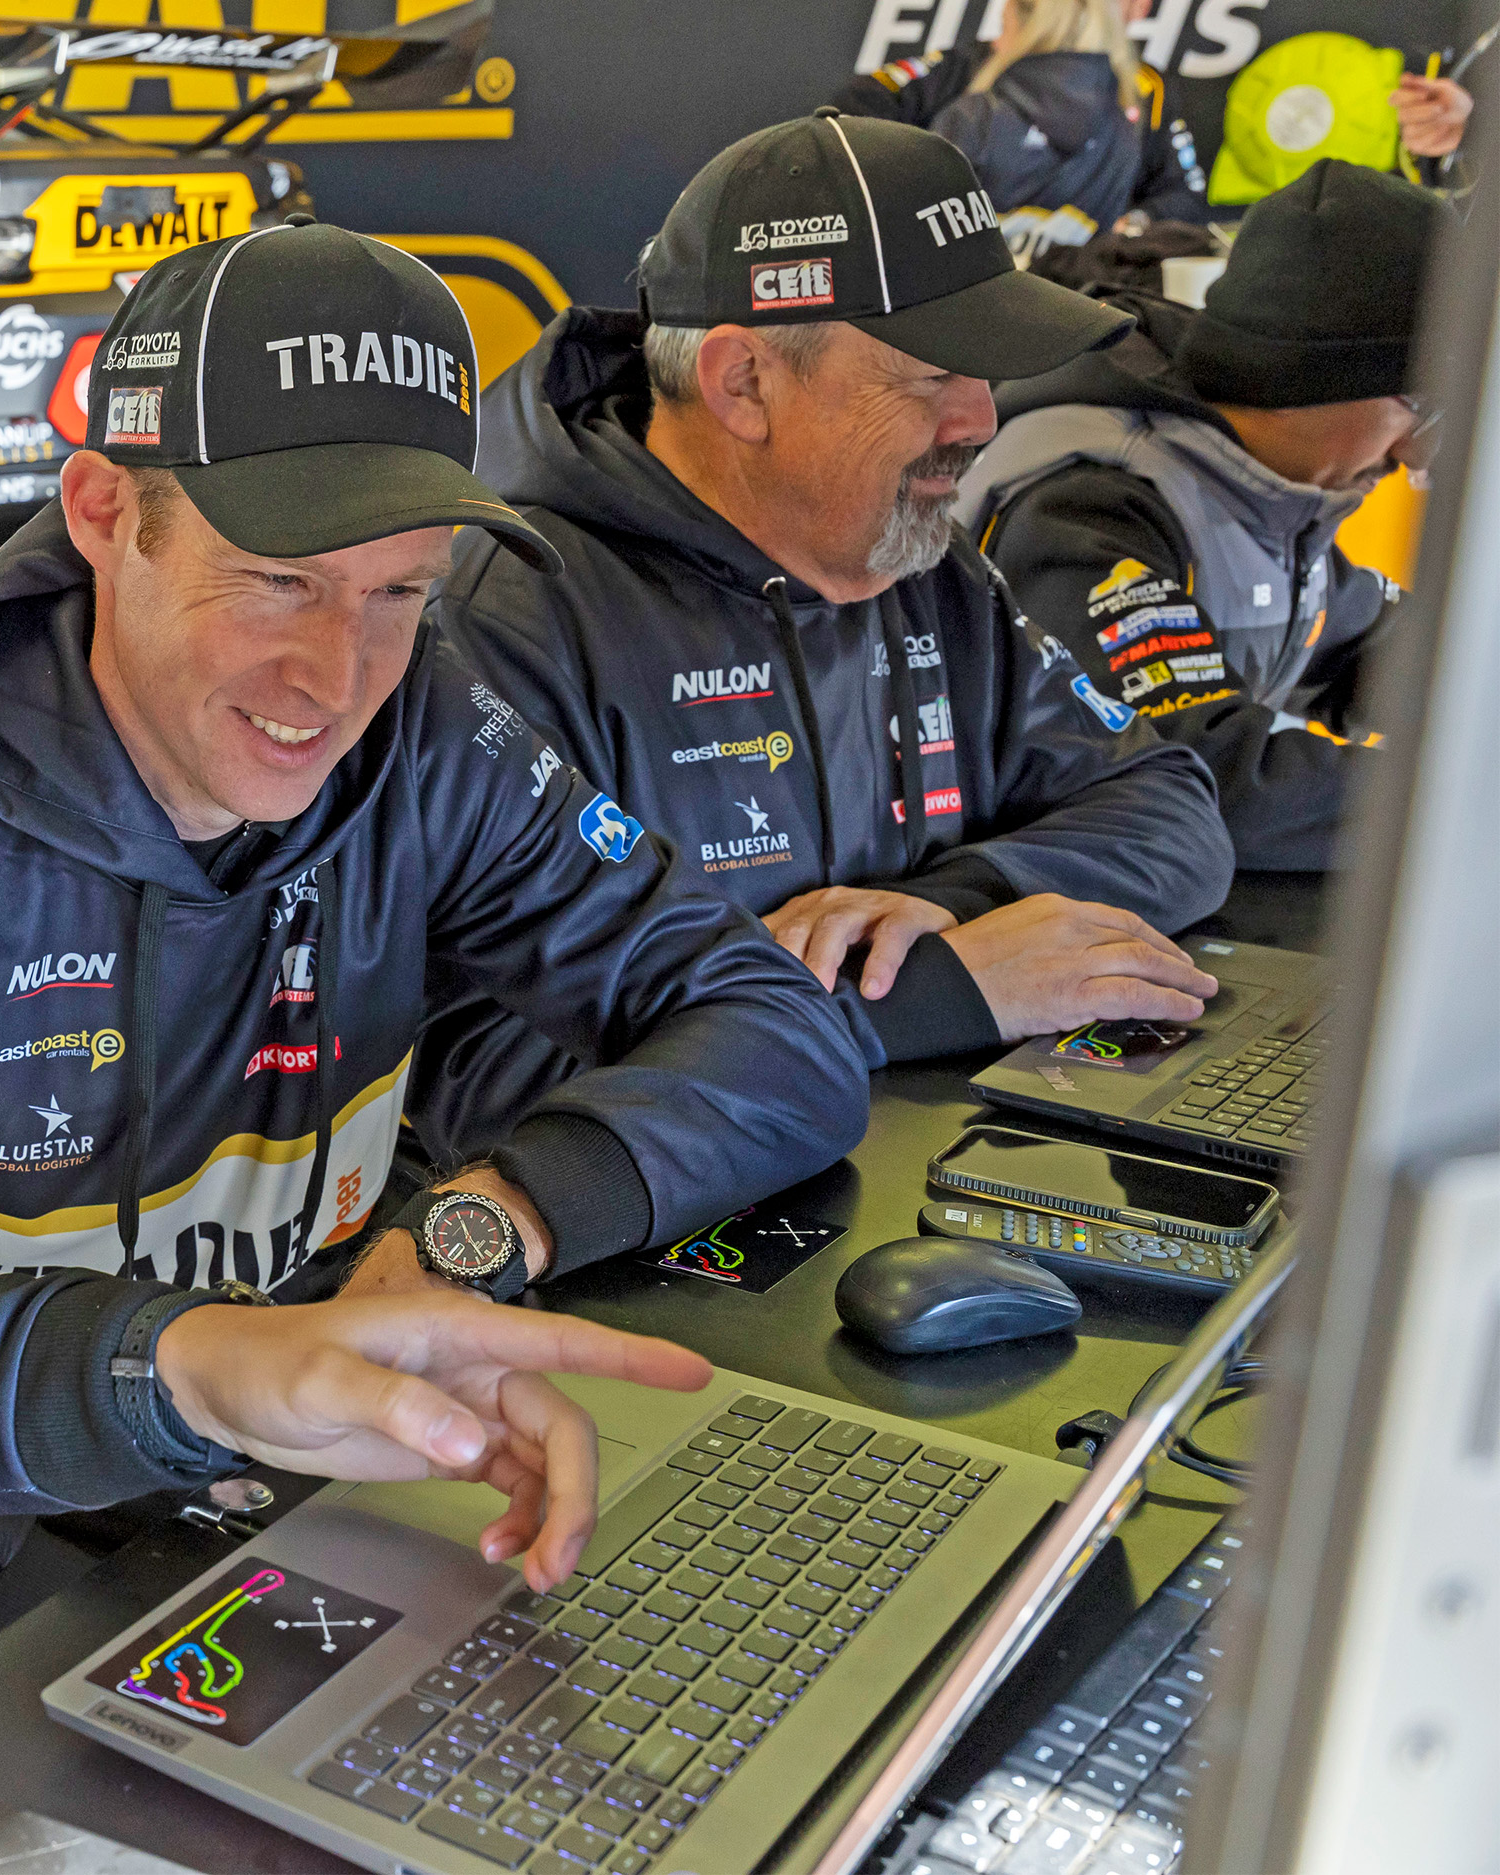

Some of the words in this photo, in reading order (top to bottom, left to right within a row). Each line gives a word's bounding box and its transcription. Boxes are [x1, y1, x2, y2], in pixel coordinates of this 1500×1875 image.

[769, 213, 848, 236] TOYOTA
[776, 233, 843, 246] FORKLIFTS
[130, 331, 181, 353] TOYOTA
[130, 354, 175, 366] FORKLIFTS
[266, 331, 458, 404] TRADIE
[672, 661, 771, 702] NULON
[700, 832, 791, 862] BLUESTAR
[703, 859, 750, 873] GLOBAL
[750, 851, 793, 867] LOGISTICS
[6, 952, 117, 996] NULON
[46, 1048, 57, 1060] car
[58, 1047, 90, 1058] rentals
[34, 1153, 93, 1173] LOGISTICS
[336, 1165, 362, 1223] eer
[94, 1704, 179, 1748] Lenovo
